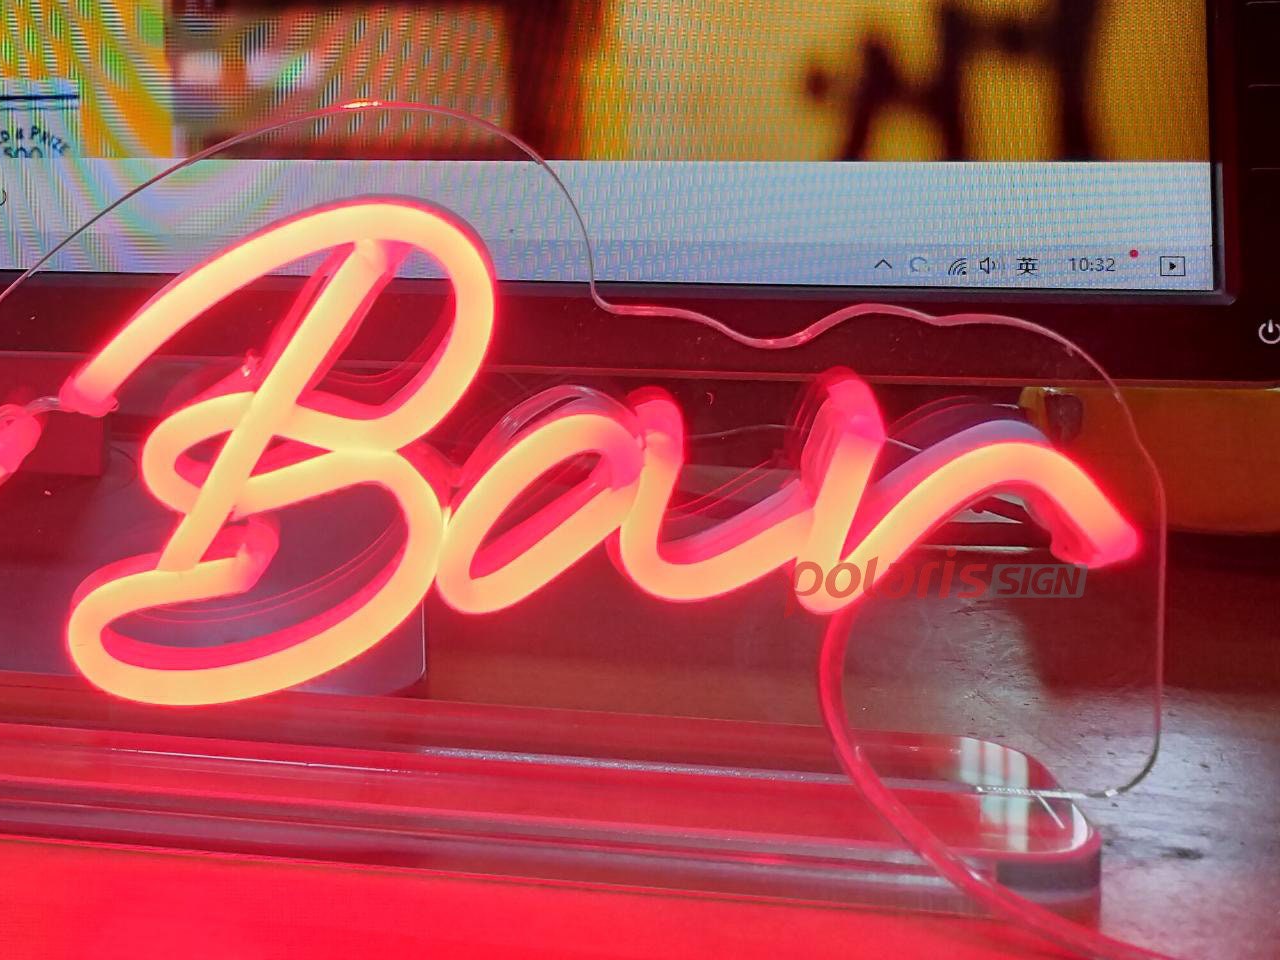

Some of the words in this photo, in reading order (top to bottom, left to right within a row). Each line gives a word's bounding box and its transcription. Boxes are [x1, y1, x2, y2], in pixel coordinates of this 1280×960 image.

[1016, 257, 1039, 276] 英
[1069, 257, 1116, 272] 10:32
[62, 198, 1142, 708] Bar
